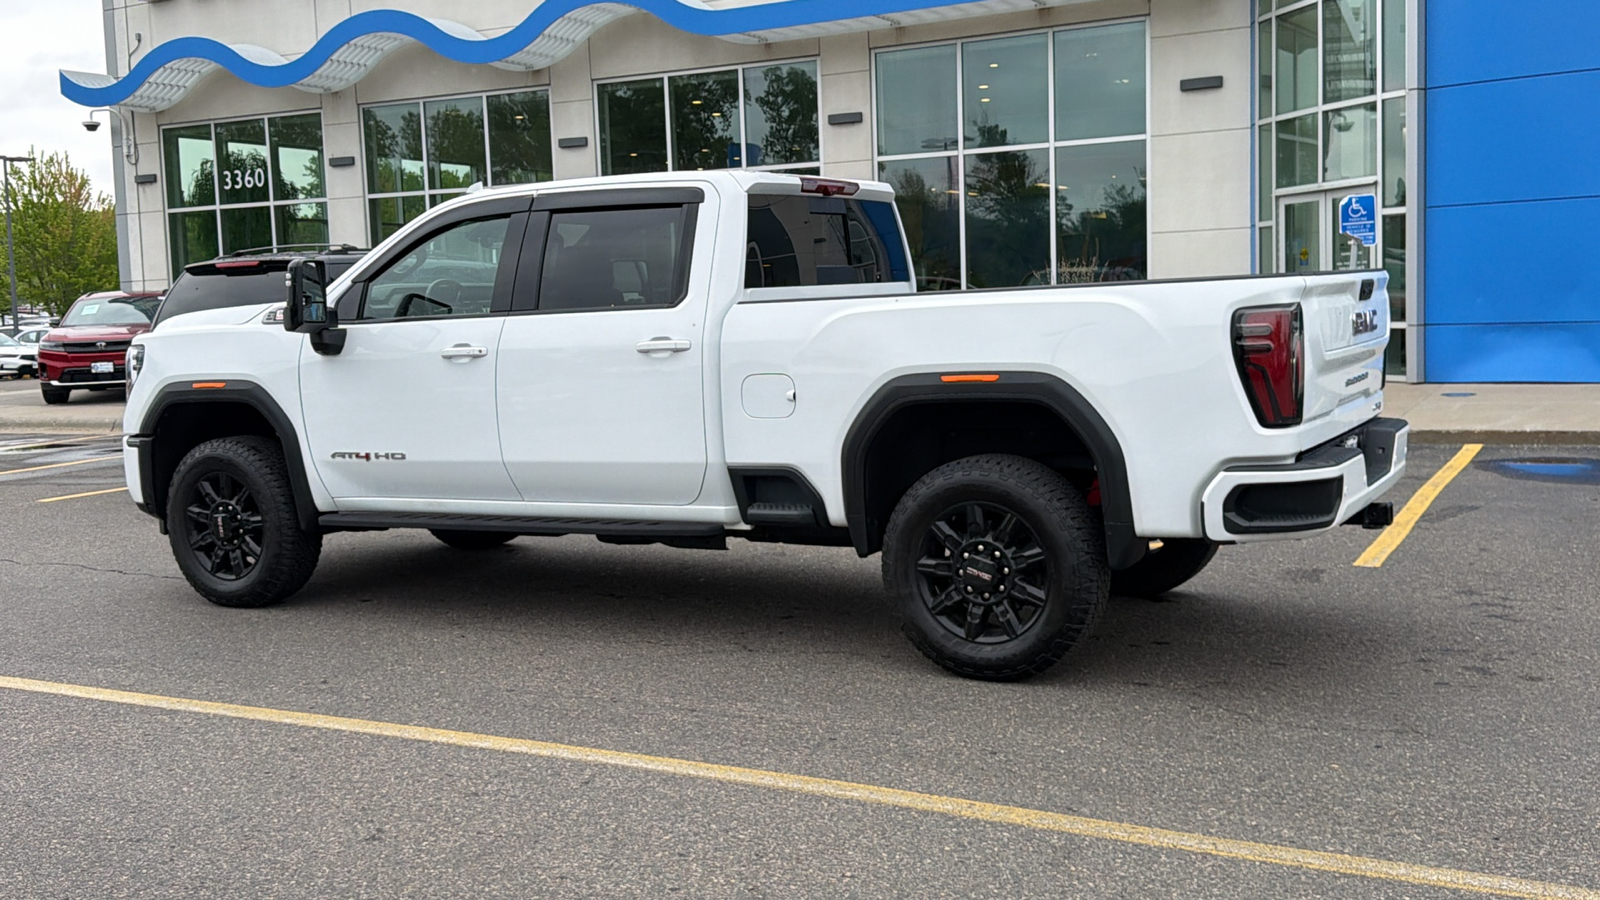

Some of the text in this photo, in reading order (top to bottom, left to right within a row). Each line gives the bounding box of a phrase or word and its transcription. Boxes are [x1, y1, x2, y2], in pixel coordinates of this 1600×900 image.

[223, 168, 265, 190] 3360
[1350, 309, 1378, 336] GMC
[330, 452, 406, 462] AT4 HD
